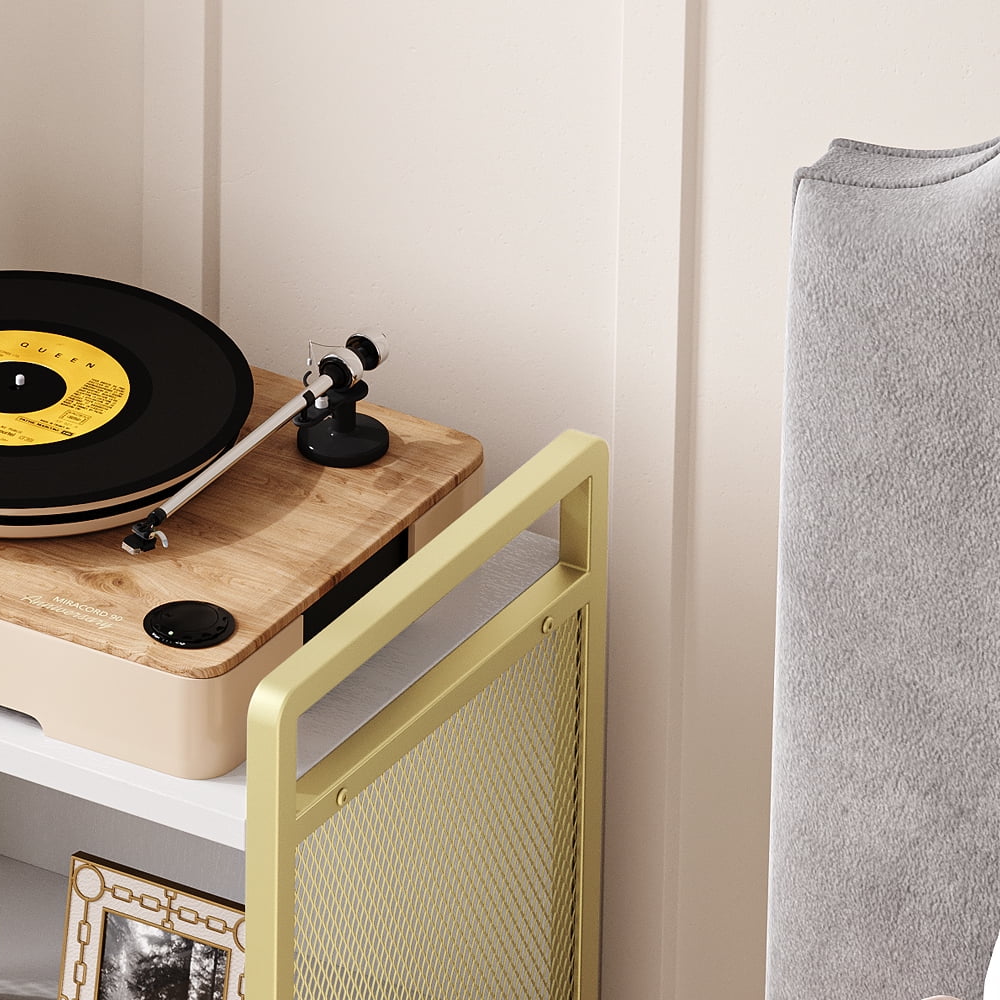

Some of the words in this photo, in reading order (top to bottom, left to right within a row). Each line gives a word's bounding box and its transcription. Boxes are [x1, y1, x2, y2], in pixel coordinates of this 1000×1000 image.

[20, 342, 95, 368] QUEEN
[20, 596, 113, 630] Anniversary
[52, 596, 108, 617] MIRACORD
[110, 614, 124, 622] 90
